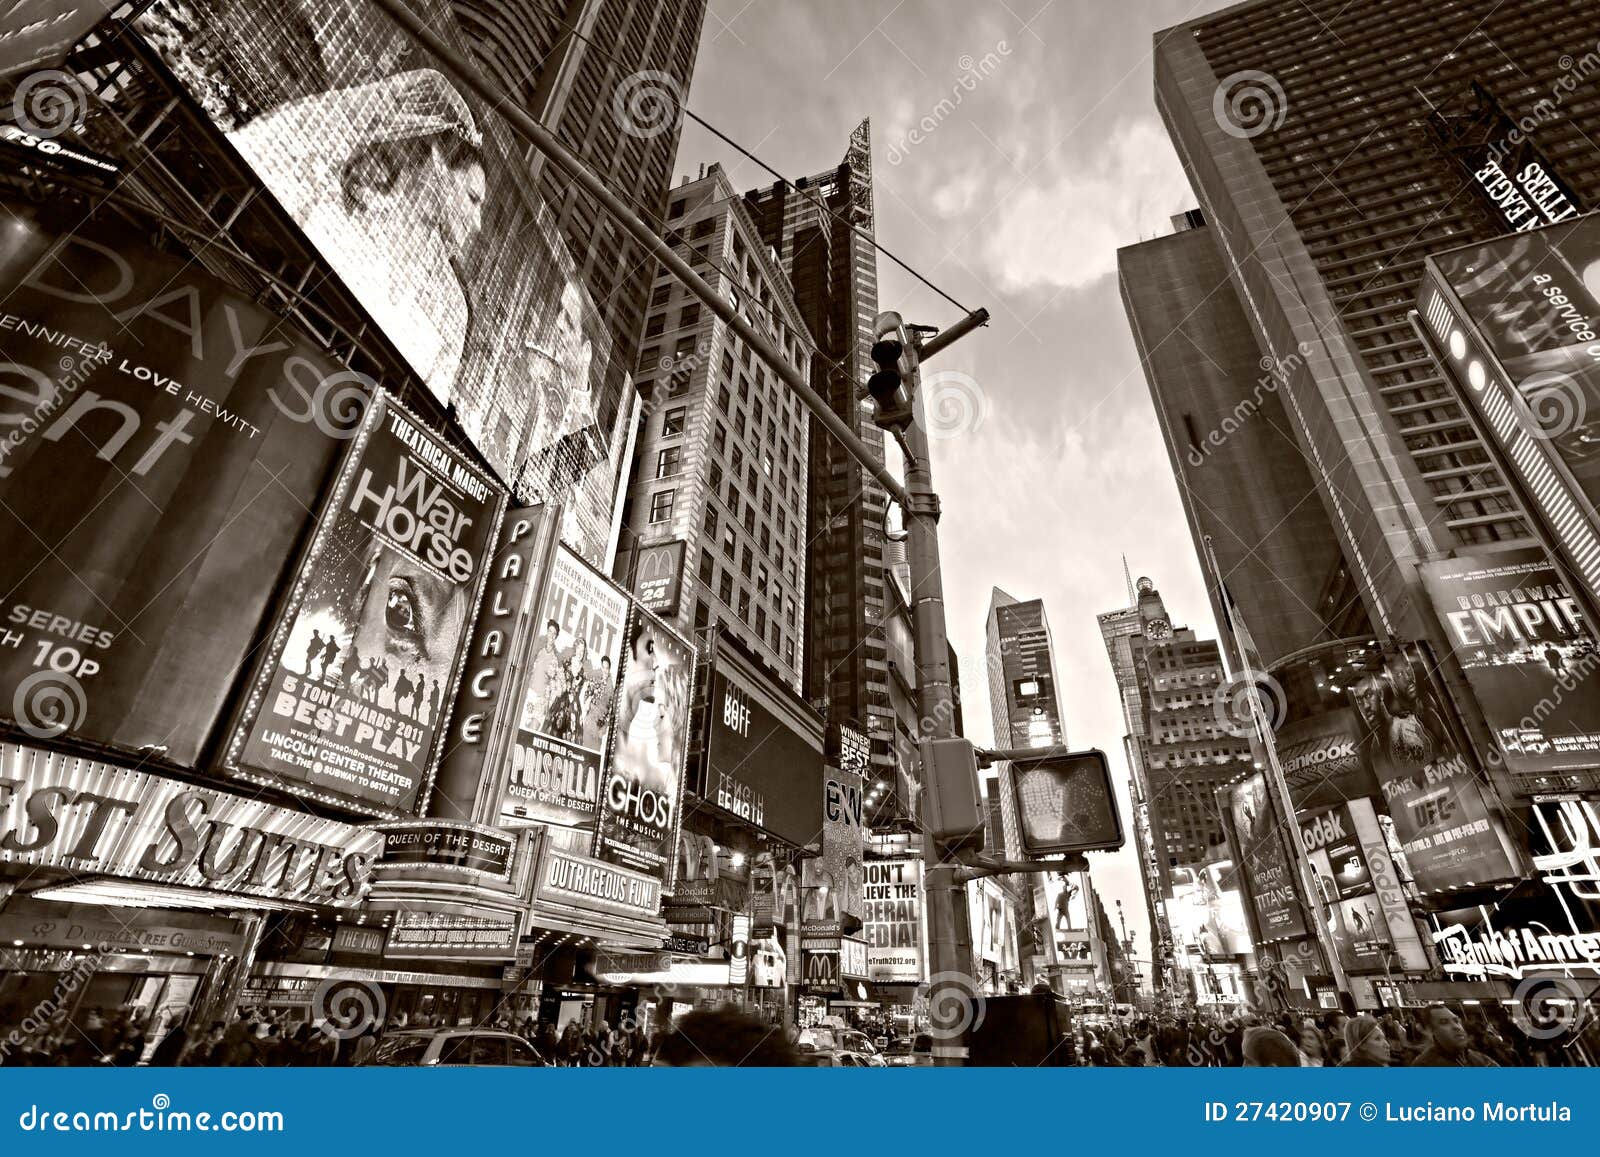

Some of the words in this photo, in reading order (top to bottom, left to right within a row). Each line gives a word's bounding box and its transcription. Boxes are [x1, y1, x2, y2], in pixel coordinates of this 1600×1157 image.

[1475, 160, 1537, 220] EAGLE
[1516, 162, 1582, 224] TTERS
[20, 232, 328, 423] DAYS
[1533, 272, 1551, 286] a
[1547, 285, 1596, 341] service
[0, 312, 112, 365] ENNIFER
[119, 359, 182, 394] LOVE
[185, 390, 260, 439] HEWITT
[350, 468, 473, 582] Horse
[395, 455, 473, 543] War
[640, 579, 670, 590] OPEN
[642, 587, 665, 601] 24
[8, 605, 115, 649] SERIES
[462, 519, 533, 744] PALACE
[545, 582, 618, 656] HEART
[272, 691, 353, 736] BEST
[353, 721, 421, 762] PLAY
[281, 674, 299, 693] 5
[302, 682, 340, 709] TONY
[395, 722, 424, 743] 2011
[261, 729, 318, 758] LINCOLN
[319, 748, 366, 773] CENTER
[366, 765, 413, 789] THEATER
[271, 747, 294, 763] TAKE
[295, 756, 313, 769] THE
[322, 765, 357, 783] SUBWAY
[358, 776, 369, 786] TO
[509, 743, 597, 802] PRISCILLA
[841, 744, 870, 768] BEST
[508, 784, 536, 800] QUEEN
[551, 795, 565, 806] THE
[567, 799, 594, 812] DESERT
[608, 774, 675, 829] GHOST
[388, 834, 420, 845] QUEEN
[424, 832, 440, 844] OF
[445, 834, 469, 846] THE
[472, 840, 506, 855] DESERT
[616, 815, 631, 829] THE
[633, 822, 664, 841] MUSICAL
[1304, 809, 1347, 851] odak
[550, 857, 627, 902] OUTRAGEOUS
[629, 876, 653, 908] FUN!
[894, 884, 916, 898] THE
[1253, 866, 1282, 884] WRATH
[1255, 885, 1295, 912] TITANS
[340, 927, 357, 948] THE
[359, 930, 380, 949] TWO
